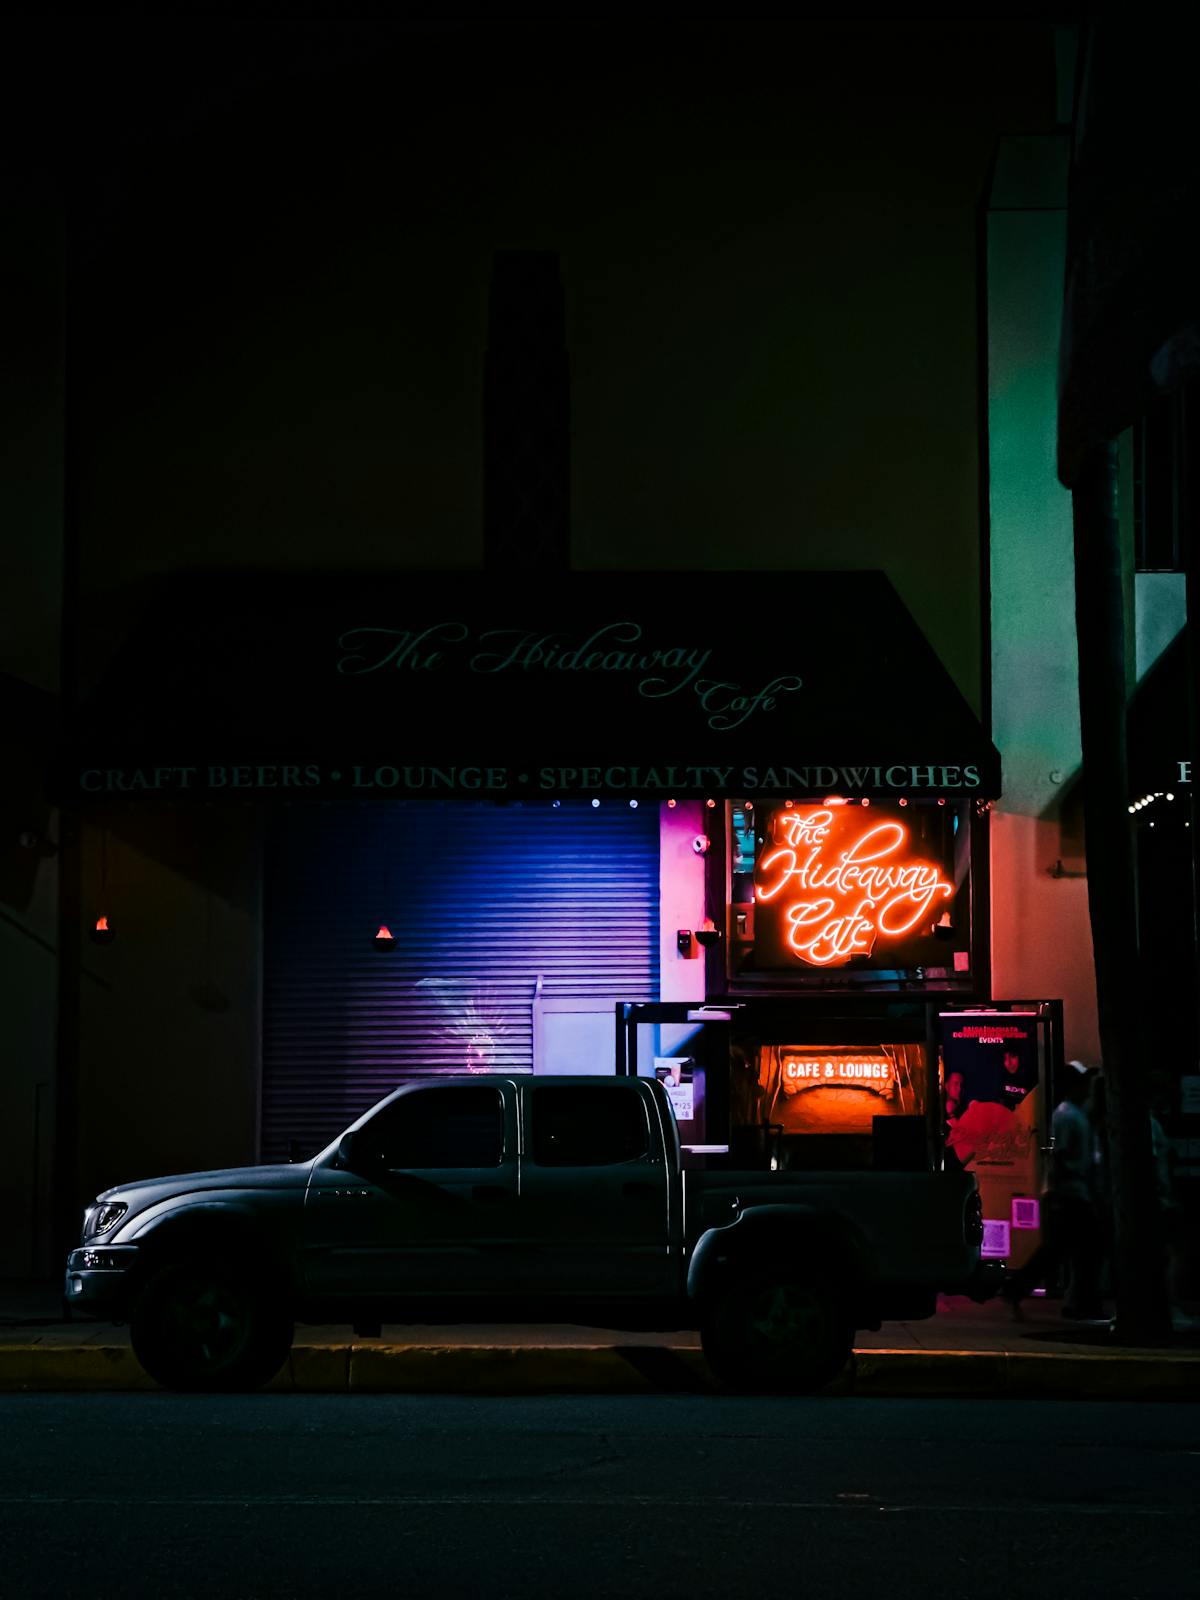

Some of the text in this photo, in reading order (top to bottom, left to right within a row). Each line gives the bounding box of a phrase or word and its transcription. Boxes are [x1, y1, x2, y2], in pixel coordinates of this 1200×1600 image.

[336, 622, 713, 698] The Hideaway
[80, 764, 981, 791] CRAFT BEERS LOUNGE SPECIALTY SANDWICHES
[782, 810, 833, 848] The
[758, 823, 952, 935] Hideaway
[787, 1062, 889, 1079] CAFE & LOUNGE
